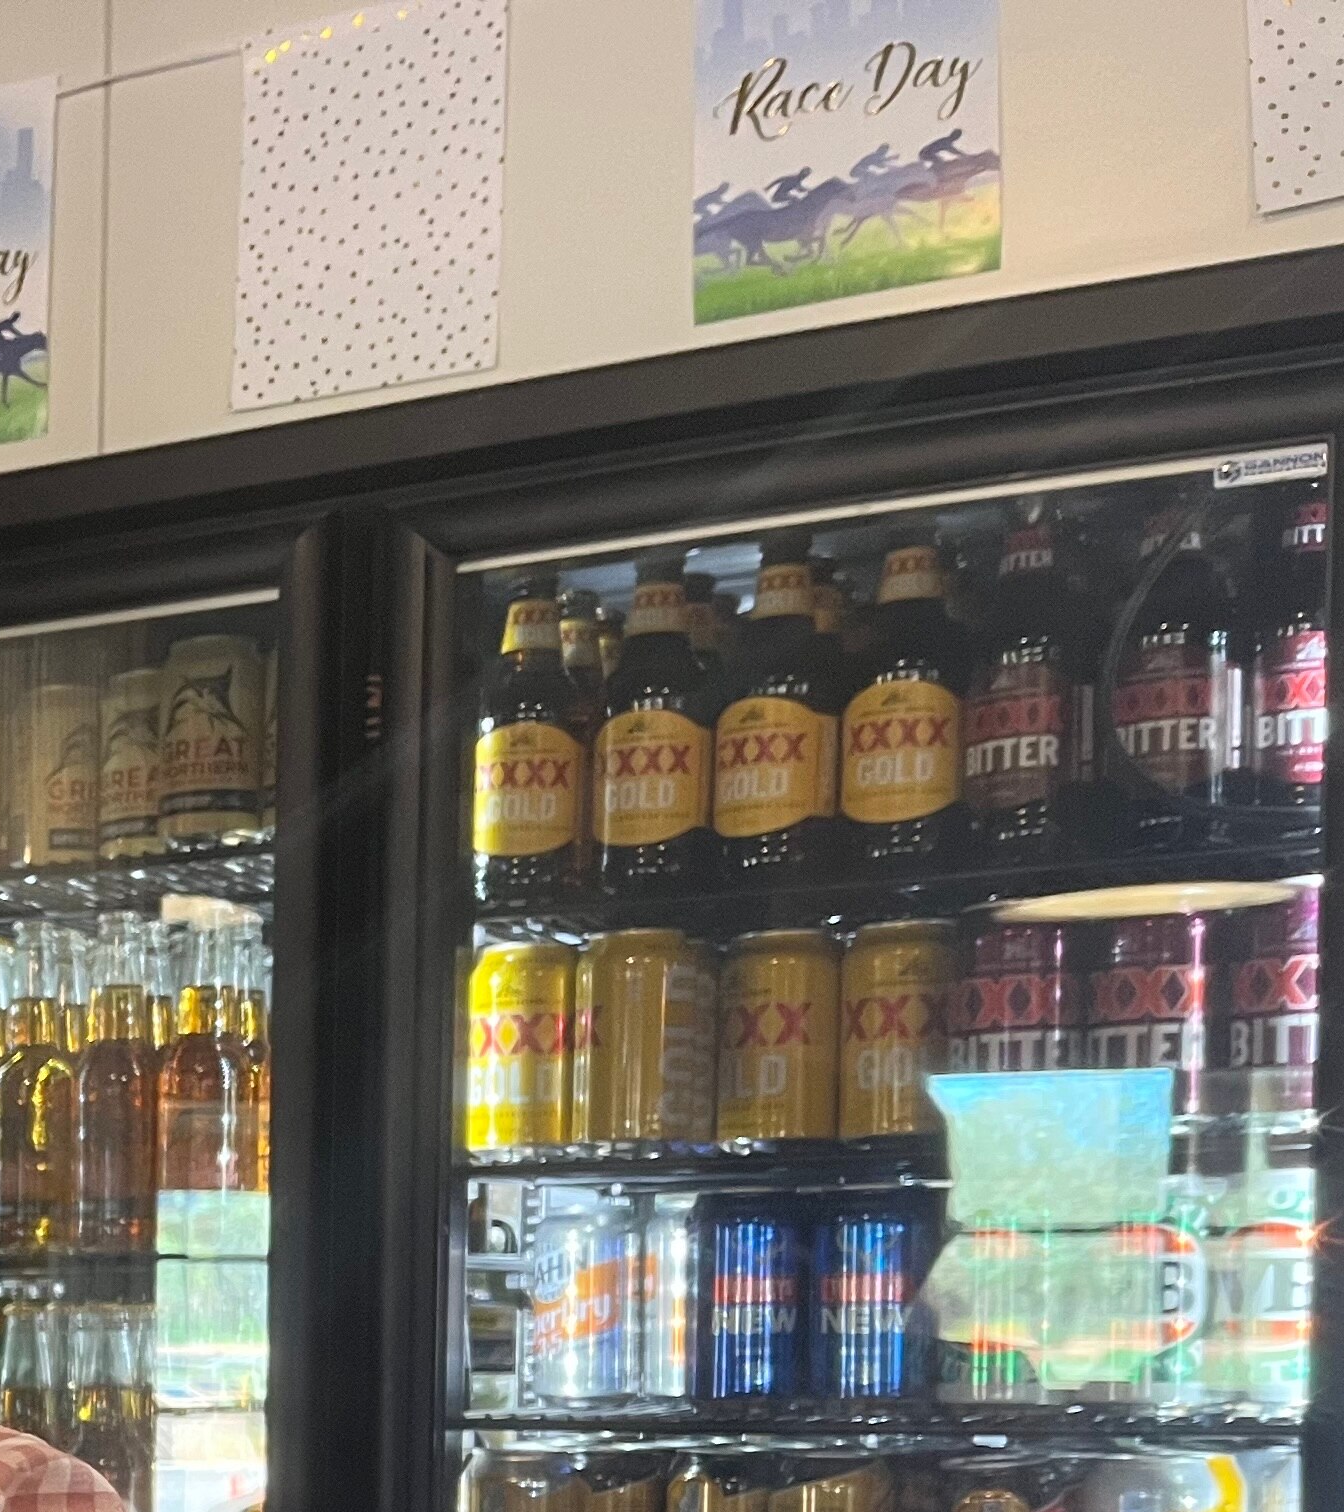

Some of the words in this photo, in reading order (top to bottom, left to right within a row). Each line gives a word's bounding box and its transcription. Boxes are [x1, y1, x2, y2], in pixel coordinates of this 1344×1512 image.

[716, 57, 853, 141] Race
[863, 41, 984, 120] Day
[850, 716, 952, 756] XXXX
[1258, 707, 1327, 750] BITT
[857, 750, 936, 788] GOLD
[1229, 1012, 1319, 1068] BITT
